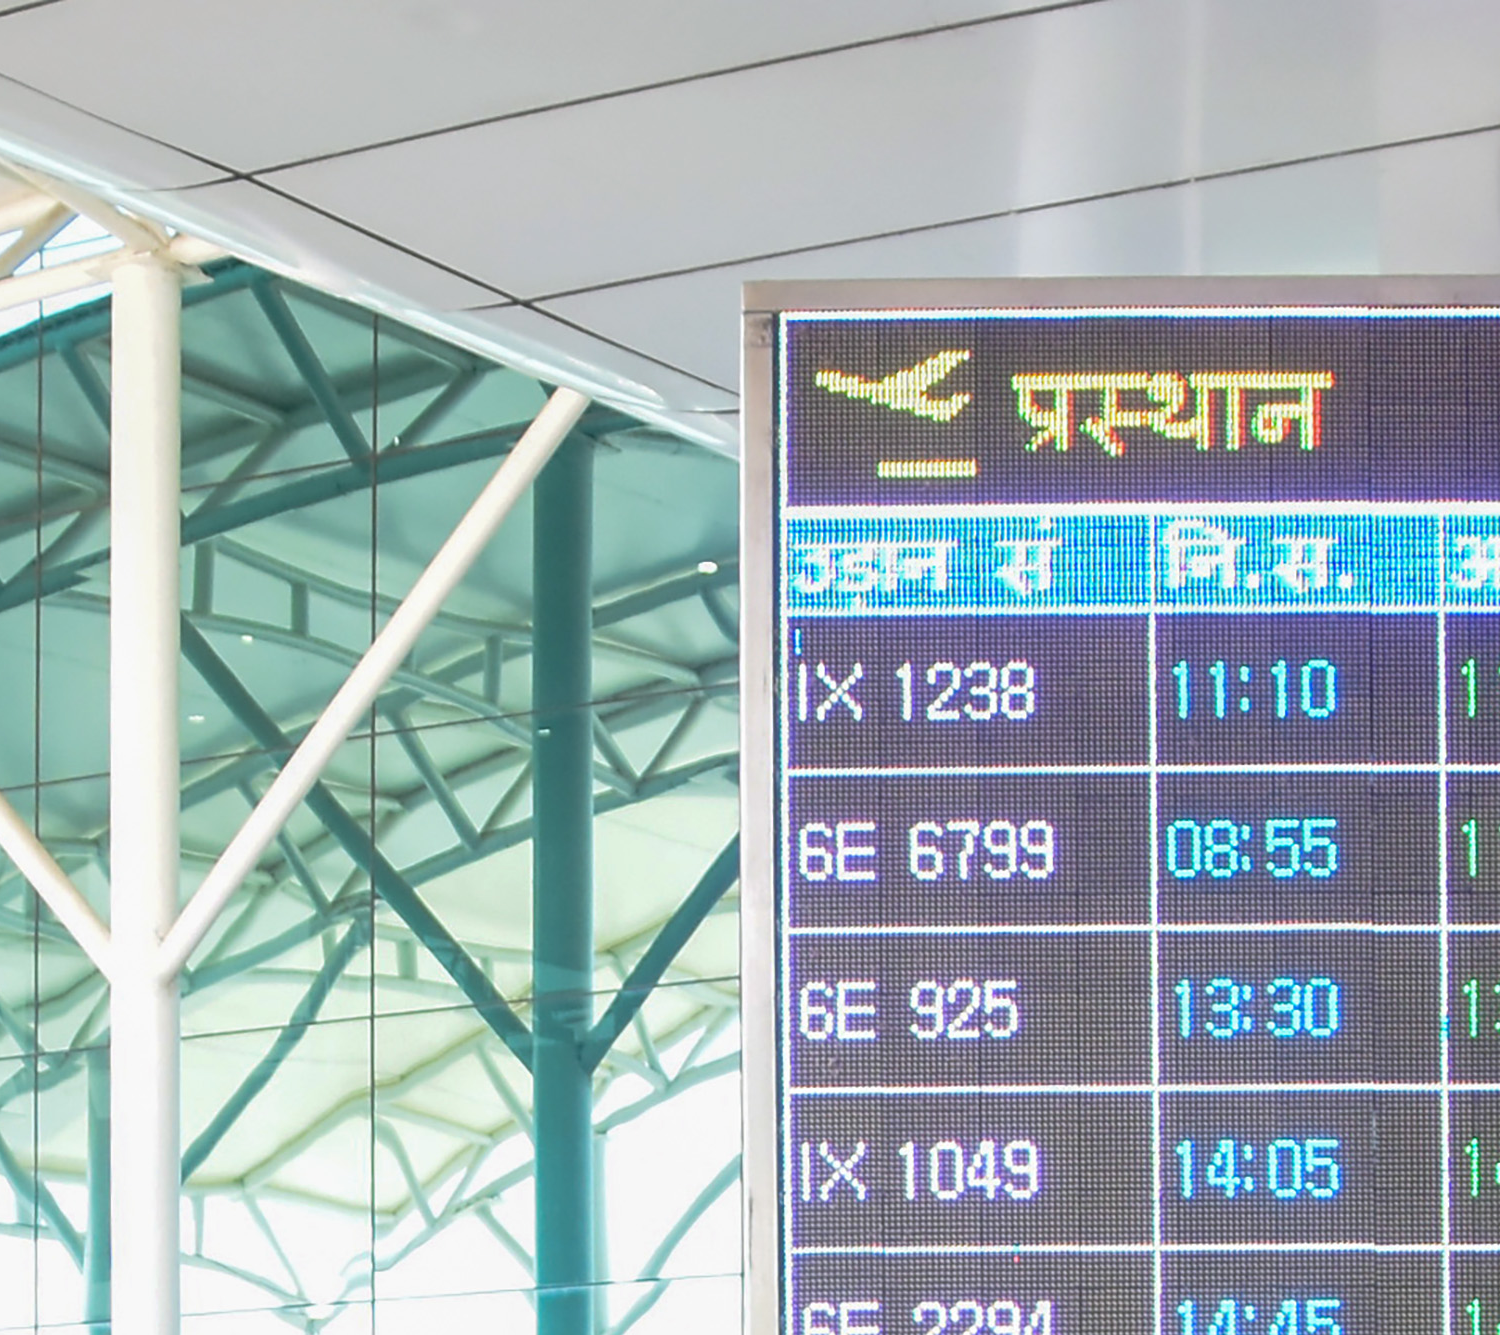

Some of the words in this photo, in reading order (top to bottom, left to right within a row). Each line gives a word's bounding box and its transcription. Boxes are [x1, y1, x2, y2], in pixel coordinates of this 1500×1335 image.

[1012, 372, 1334, 455] प्रस्थान
[996, 518, 1062, 596] सं
[1162, 519, 1353, 596] नि.स.
[797, 661, 863, 721] IX
[897, 662, 1037, 721] 1238
[1173, 660, 1339, 718] 11:10
[797, 821, 877, 881] 6E
[910, 820, 1057, 880] 6799
[1167, 819, 1338, 878] 08:55
[798, 980, 876, 1041] 6E
[910, 979, 1020, 1040] 925
[1176, 979, 1342, 1038] 13:30
[801, 1141, 868, 1202] IX
[900, 1140, 1042, 1200] 1049
[1176, 1139, 1342, 1199] 14:05
